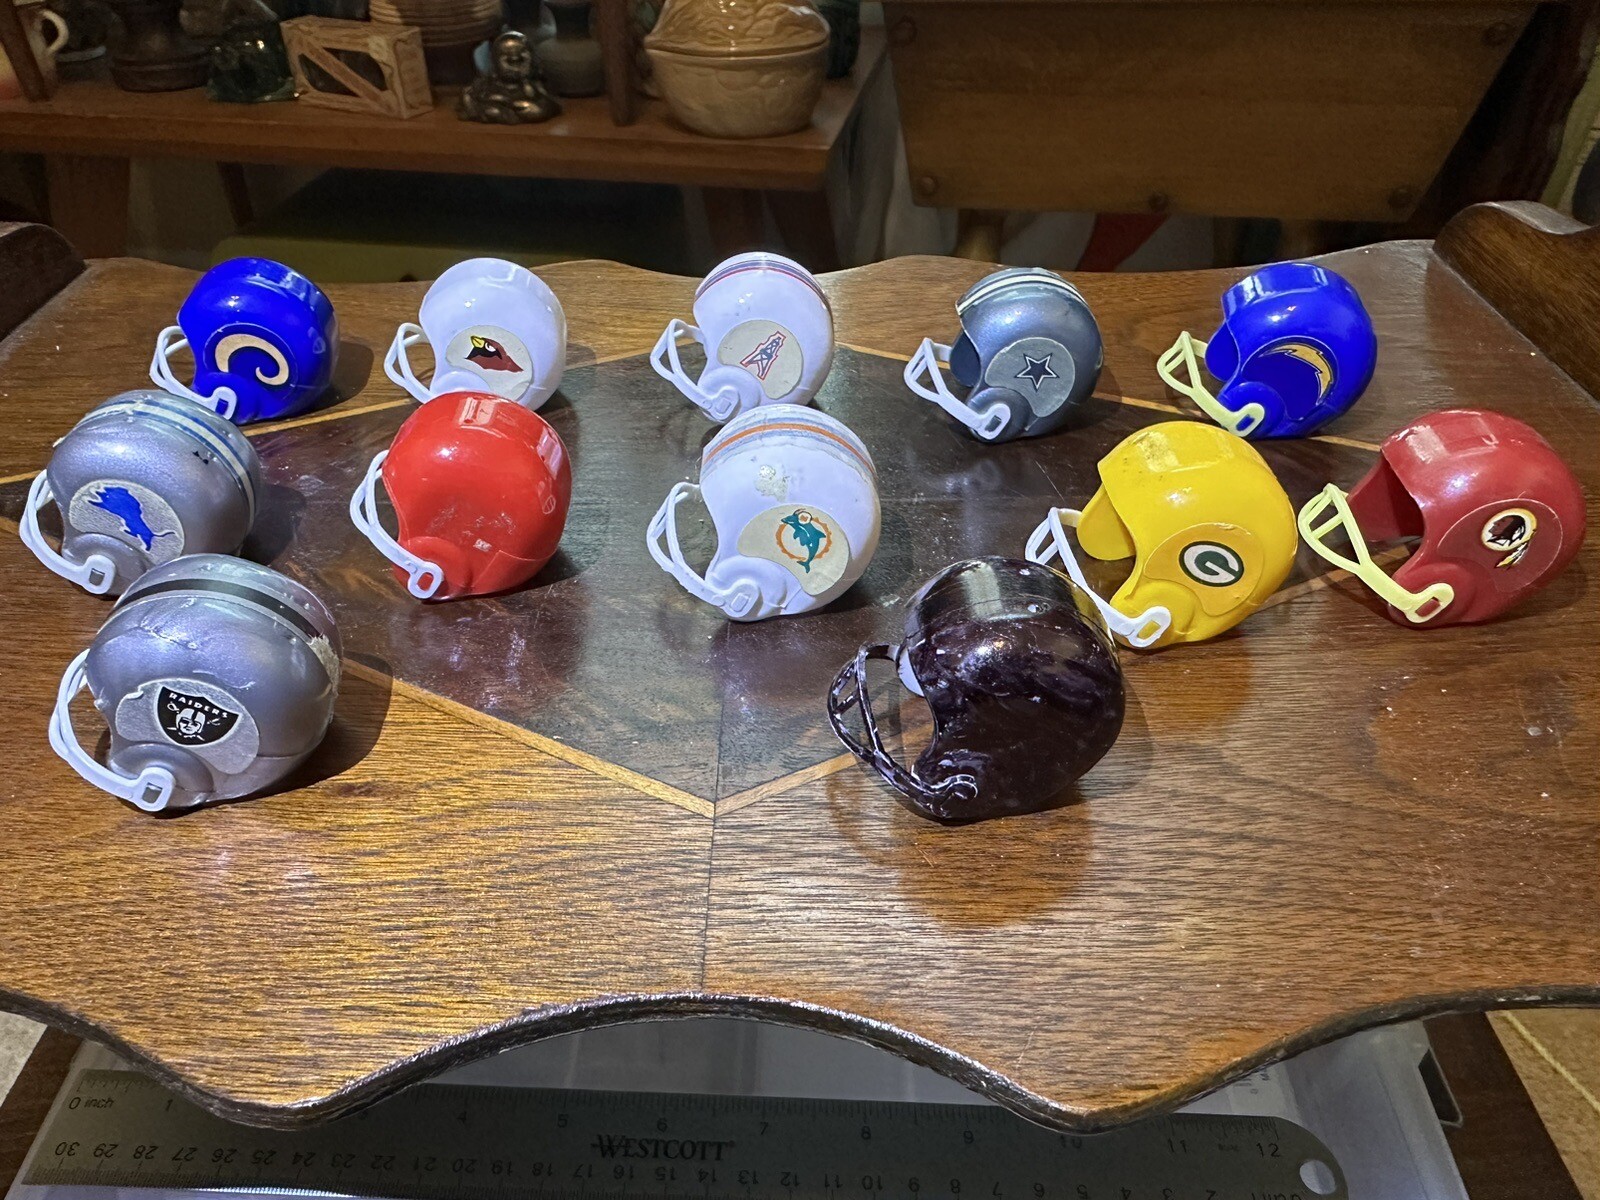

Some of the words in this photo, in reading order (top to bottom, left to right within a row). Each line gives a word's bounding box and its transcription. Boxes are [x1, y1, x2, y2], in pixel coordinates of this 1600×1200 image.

[1182, 543, 1240, 585] G
[168, 692, 229, 719] RAIDERS
[68, 1097, 81, 1110] 0
[84, 1097, 115, 1109] inch
[164, 1099, 173, 1113] 1
[556, 1113, 569, 1128] 5
[656, 1117, 668, 1133] 6
[760, 1121, 769, 1136] 7
[860, 1125, 872, 1140] 8
[963, 1129, 975, 1144] 9
[1167, 1138, 1189, 1154] 11
[1256, 1142, 1280, 1159] 12
[54, 1141, 81, 1157] 30
[93, 1143, 119, 1158] 29
[132, 1144, 160, 1160] 28
[171, 1146, 199, 1161] 27
[211, 1148, 238, 1163] 26
[591, 1134, 728, 1161] WESTCOTT
[251, 1149, 277, 1165] 25
[291, 1151, 317, 1167] 24
[330, 1153, 356, 1169] 23
[370, 1155, 396, 1171] 22
[412, 1156, 438, 1172] 21
[451, 1159, 478, 1174] 20
[491, 1160, 514, 1176] 19
[531, 1161, 554, 1177] 18
[572, 1163, 593, 1179] 17
[613, 1165, 635, 1180] 16
[655, 1166, 677, 1181] 15
[698, 1168, 718, 1183] 14
[737, 1169, 760, 1185] 13
[780, 1171, 800, 1187] 12
[824, 1173, 844, 1189] 11
[861, 1175, 883, 1191] 10
[949, 1178, 961, 1194] 8
[992, 1181, 1004, 1196] 7
[1076, 1184, 1089, 1200] 5
[1120, 1186, 1133, 1200] 4
[1162, 1187, 1177, 1200] 3
